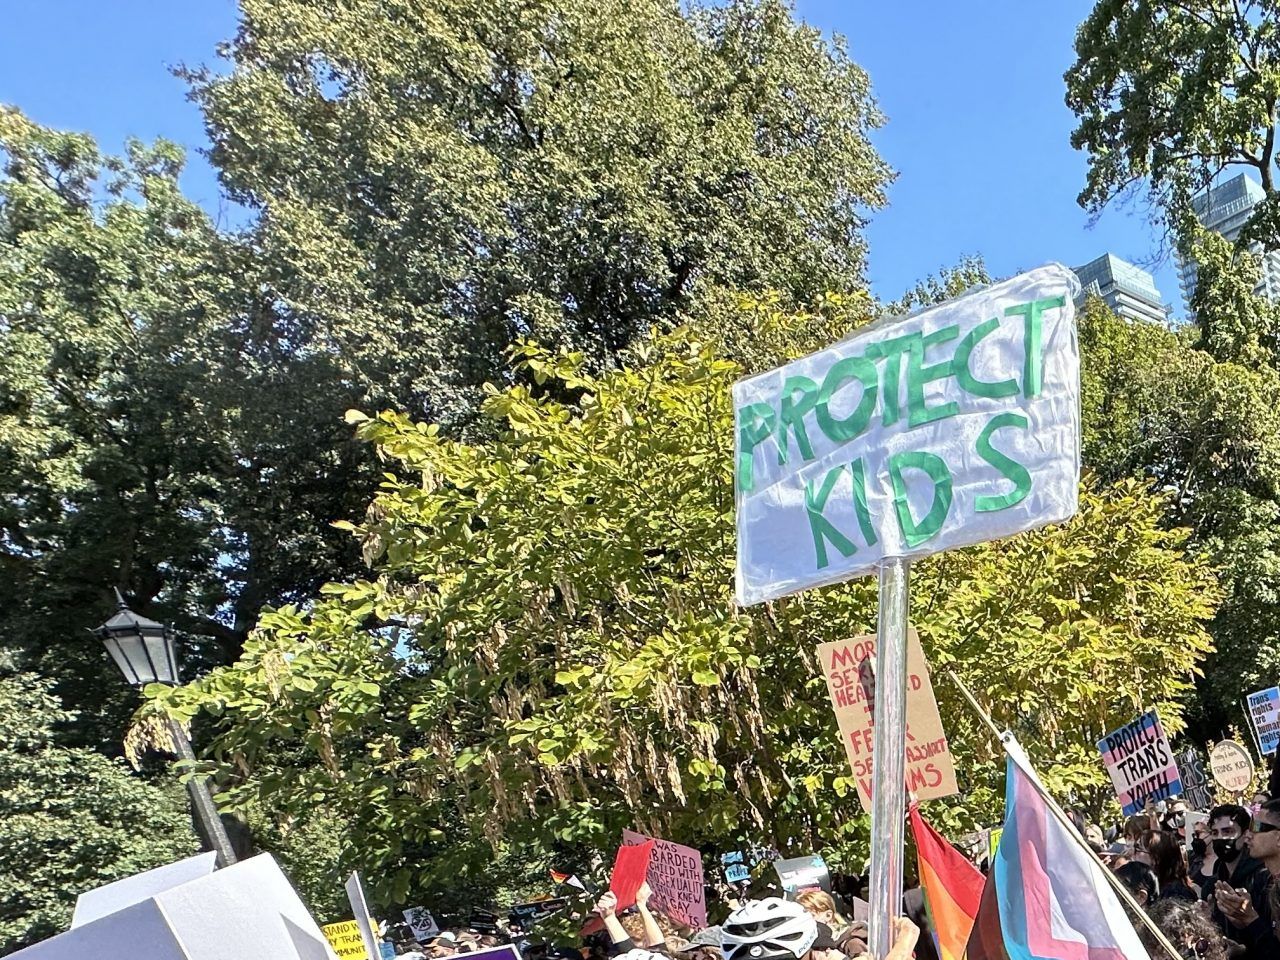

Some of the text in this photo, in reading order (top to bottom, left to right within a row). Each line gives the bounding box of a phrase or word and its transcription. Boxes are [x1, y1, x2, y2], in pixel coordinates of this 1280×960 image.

[738, 296, 1066, 490] PROTECT
[806, 413, 1032, 569] KIDS
[831, 640, 877, 670] MOR
[1249, 694, 1269, 706] Trans
[1252, 703, 1273, 716] rights
[1255, 715, 1266, 724] are
[1106, 712, 1159, 762] PROTECT
[1260, 731, 1280, 744] rights
[1117, 739, 1168, 785] TRANS
[1127, 771, 1169, 811] YOUTH
[655, 841, 677, 853] WAS
[649, 848, 696, 870] BARDED
[650, 861, 700, 881] CHILD WITH
[670, 898, 690, 914] GAY
[323, 922, 350, 936] STAND
[341, 933, 362, 944] TRAN
[334, 945, 366, 957] MMUNIT
